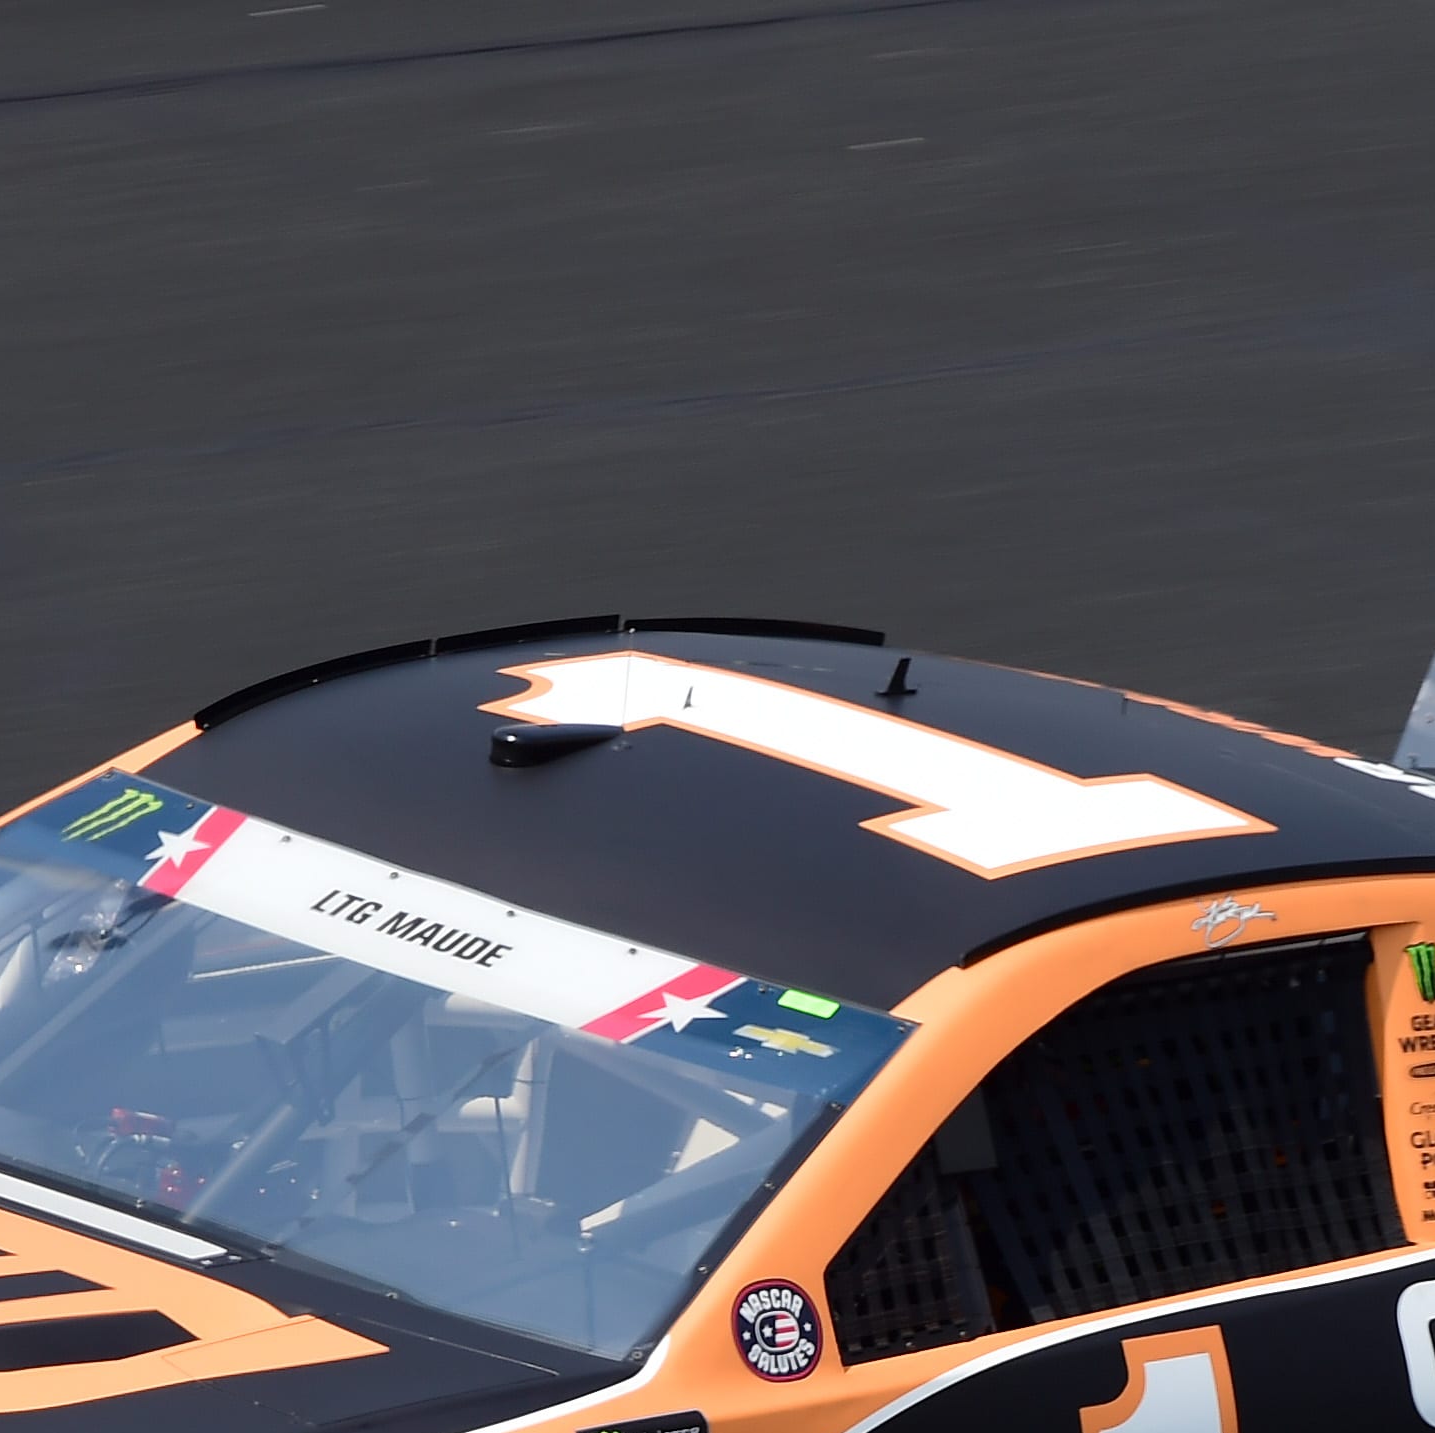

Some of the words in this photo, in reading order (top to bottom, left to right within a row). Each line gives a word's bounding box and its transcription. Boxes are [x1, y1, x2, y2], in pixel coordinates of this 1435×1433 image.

[477, 650, 1279, 880] 1
[310, 889, 383, 925] LTG
[376, 911, 514, 968] MAUDE
[739, 1288, 804, 1324] NASCAR
[748, 1338, 815, 1374] SALUTES
